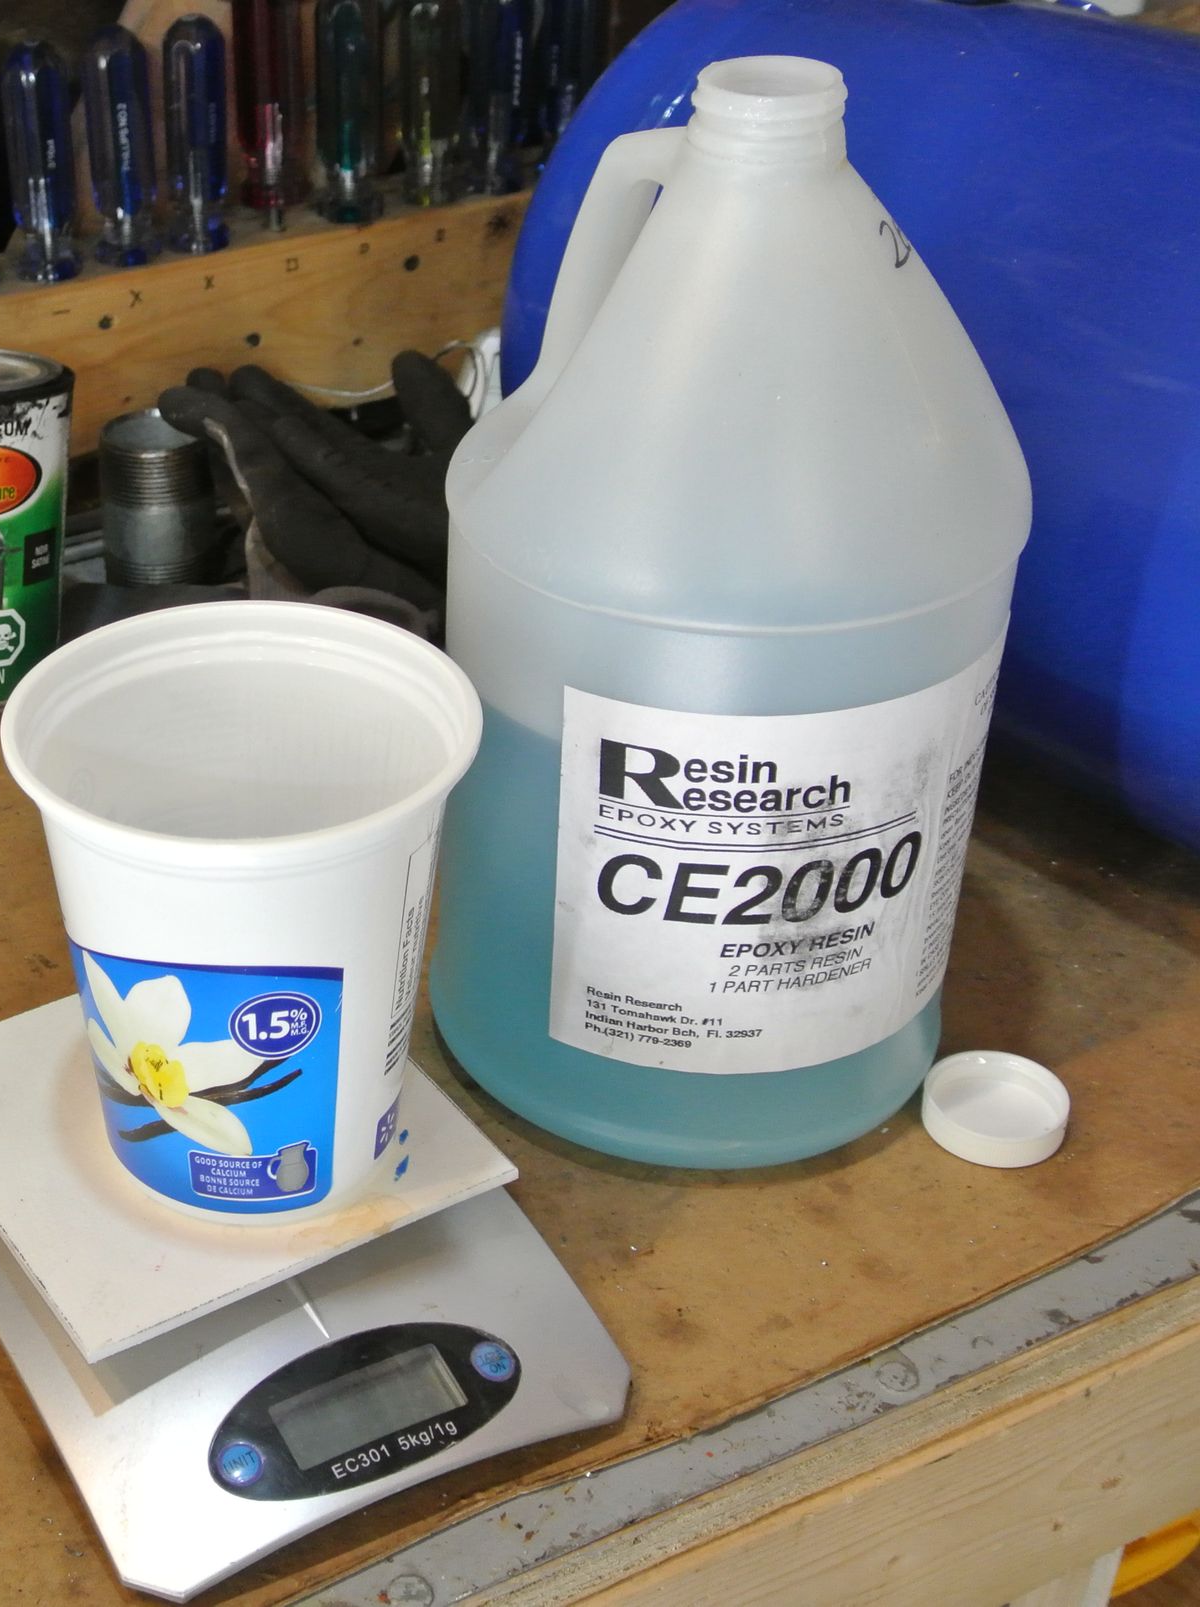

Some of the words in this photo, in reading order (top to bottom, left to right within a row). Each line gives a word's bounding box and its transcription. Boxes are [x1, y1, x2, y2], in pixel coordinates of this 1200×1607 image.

[599, 804, 697, 832] EPOXY
[707, 814, 845, 835] SYSTEMS
[597, 831, 923, 925] CE2000
[403, 906, 415, 948] Facts
[720, 939, 804, 958] EPOXY
[809, 922, 875, 951] RESIN
[729, 965, 740, 977] 2
[745, 960, 806, 977] PARTS
[810, 946, 863, 970] RESIN
[709, 982, 717, 993] 1
[723, 980, 775, 993] PART
[777, 958, 873, 990] HARDENER
[586, 986, 621, 1002] Resin
[625, 995, 683, 1012] Research
[585, 1011, 623, 1027] Indian
[627, 1020, 669, 1035] Harbor
[672, 1027, 700, 1039] Bch,
[726, 1029, 763, 1039] 32937
[586, 1000, 606, 1011] 131
[611, 1005, 677, 1023] Tomahawk
[680, 1016, 698, 1026] Dr.
[702, 1018, 723, 1026] #11
[290, 1027, 310, 1036] M.G.
[638, 1034, 693, 1048] 779-2369
[194, 1156, 217, 1167] GOOD
[219, 1160, 250, 1169] SOURCE
[252, 1161, 262, 1169] OF
[211, 1168, 247, 1177] CALCIUM
[200, 1174, 228, 1185] BONNE
[229, 1179, 260, 1187] SOURCE
[207, 1185, 217, 1193] DE
[219, 1186, 254, 1196] CALCIUM
[223, 1450, 255, 1475] UNIT
[331, 1444, 391, 1479] EC301
[397, 1421, 458, 1450] 5kg/1g
